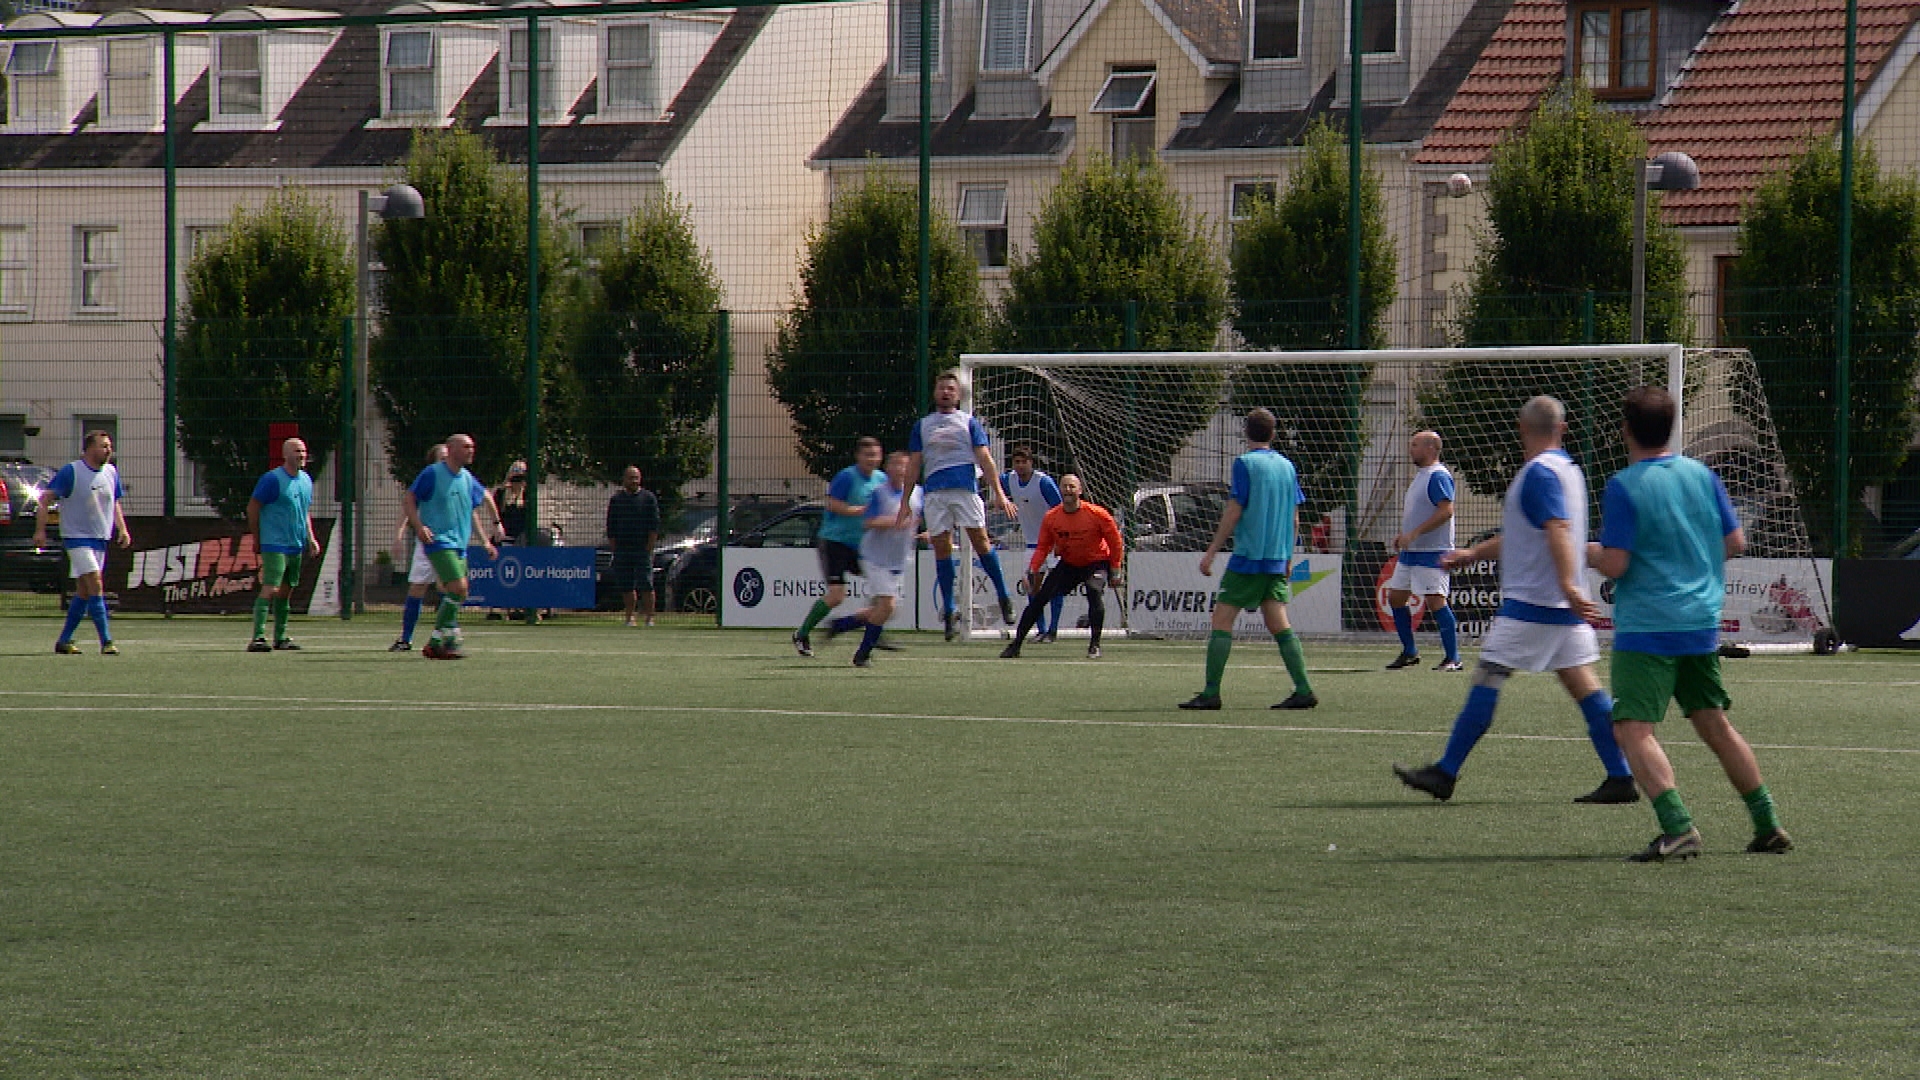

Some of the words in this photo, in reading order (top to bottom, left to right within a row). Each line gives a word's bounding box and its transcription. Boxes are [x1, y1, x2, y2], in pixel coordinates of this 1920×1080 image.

[525, 565, 545, 579] Our
[546, 565, 591, 582] Hospital
[163, 584, 188, 602] The
[190, 580, 207, 597] FA
[1131, 589, 1207, 613] POWER
